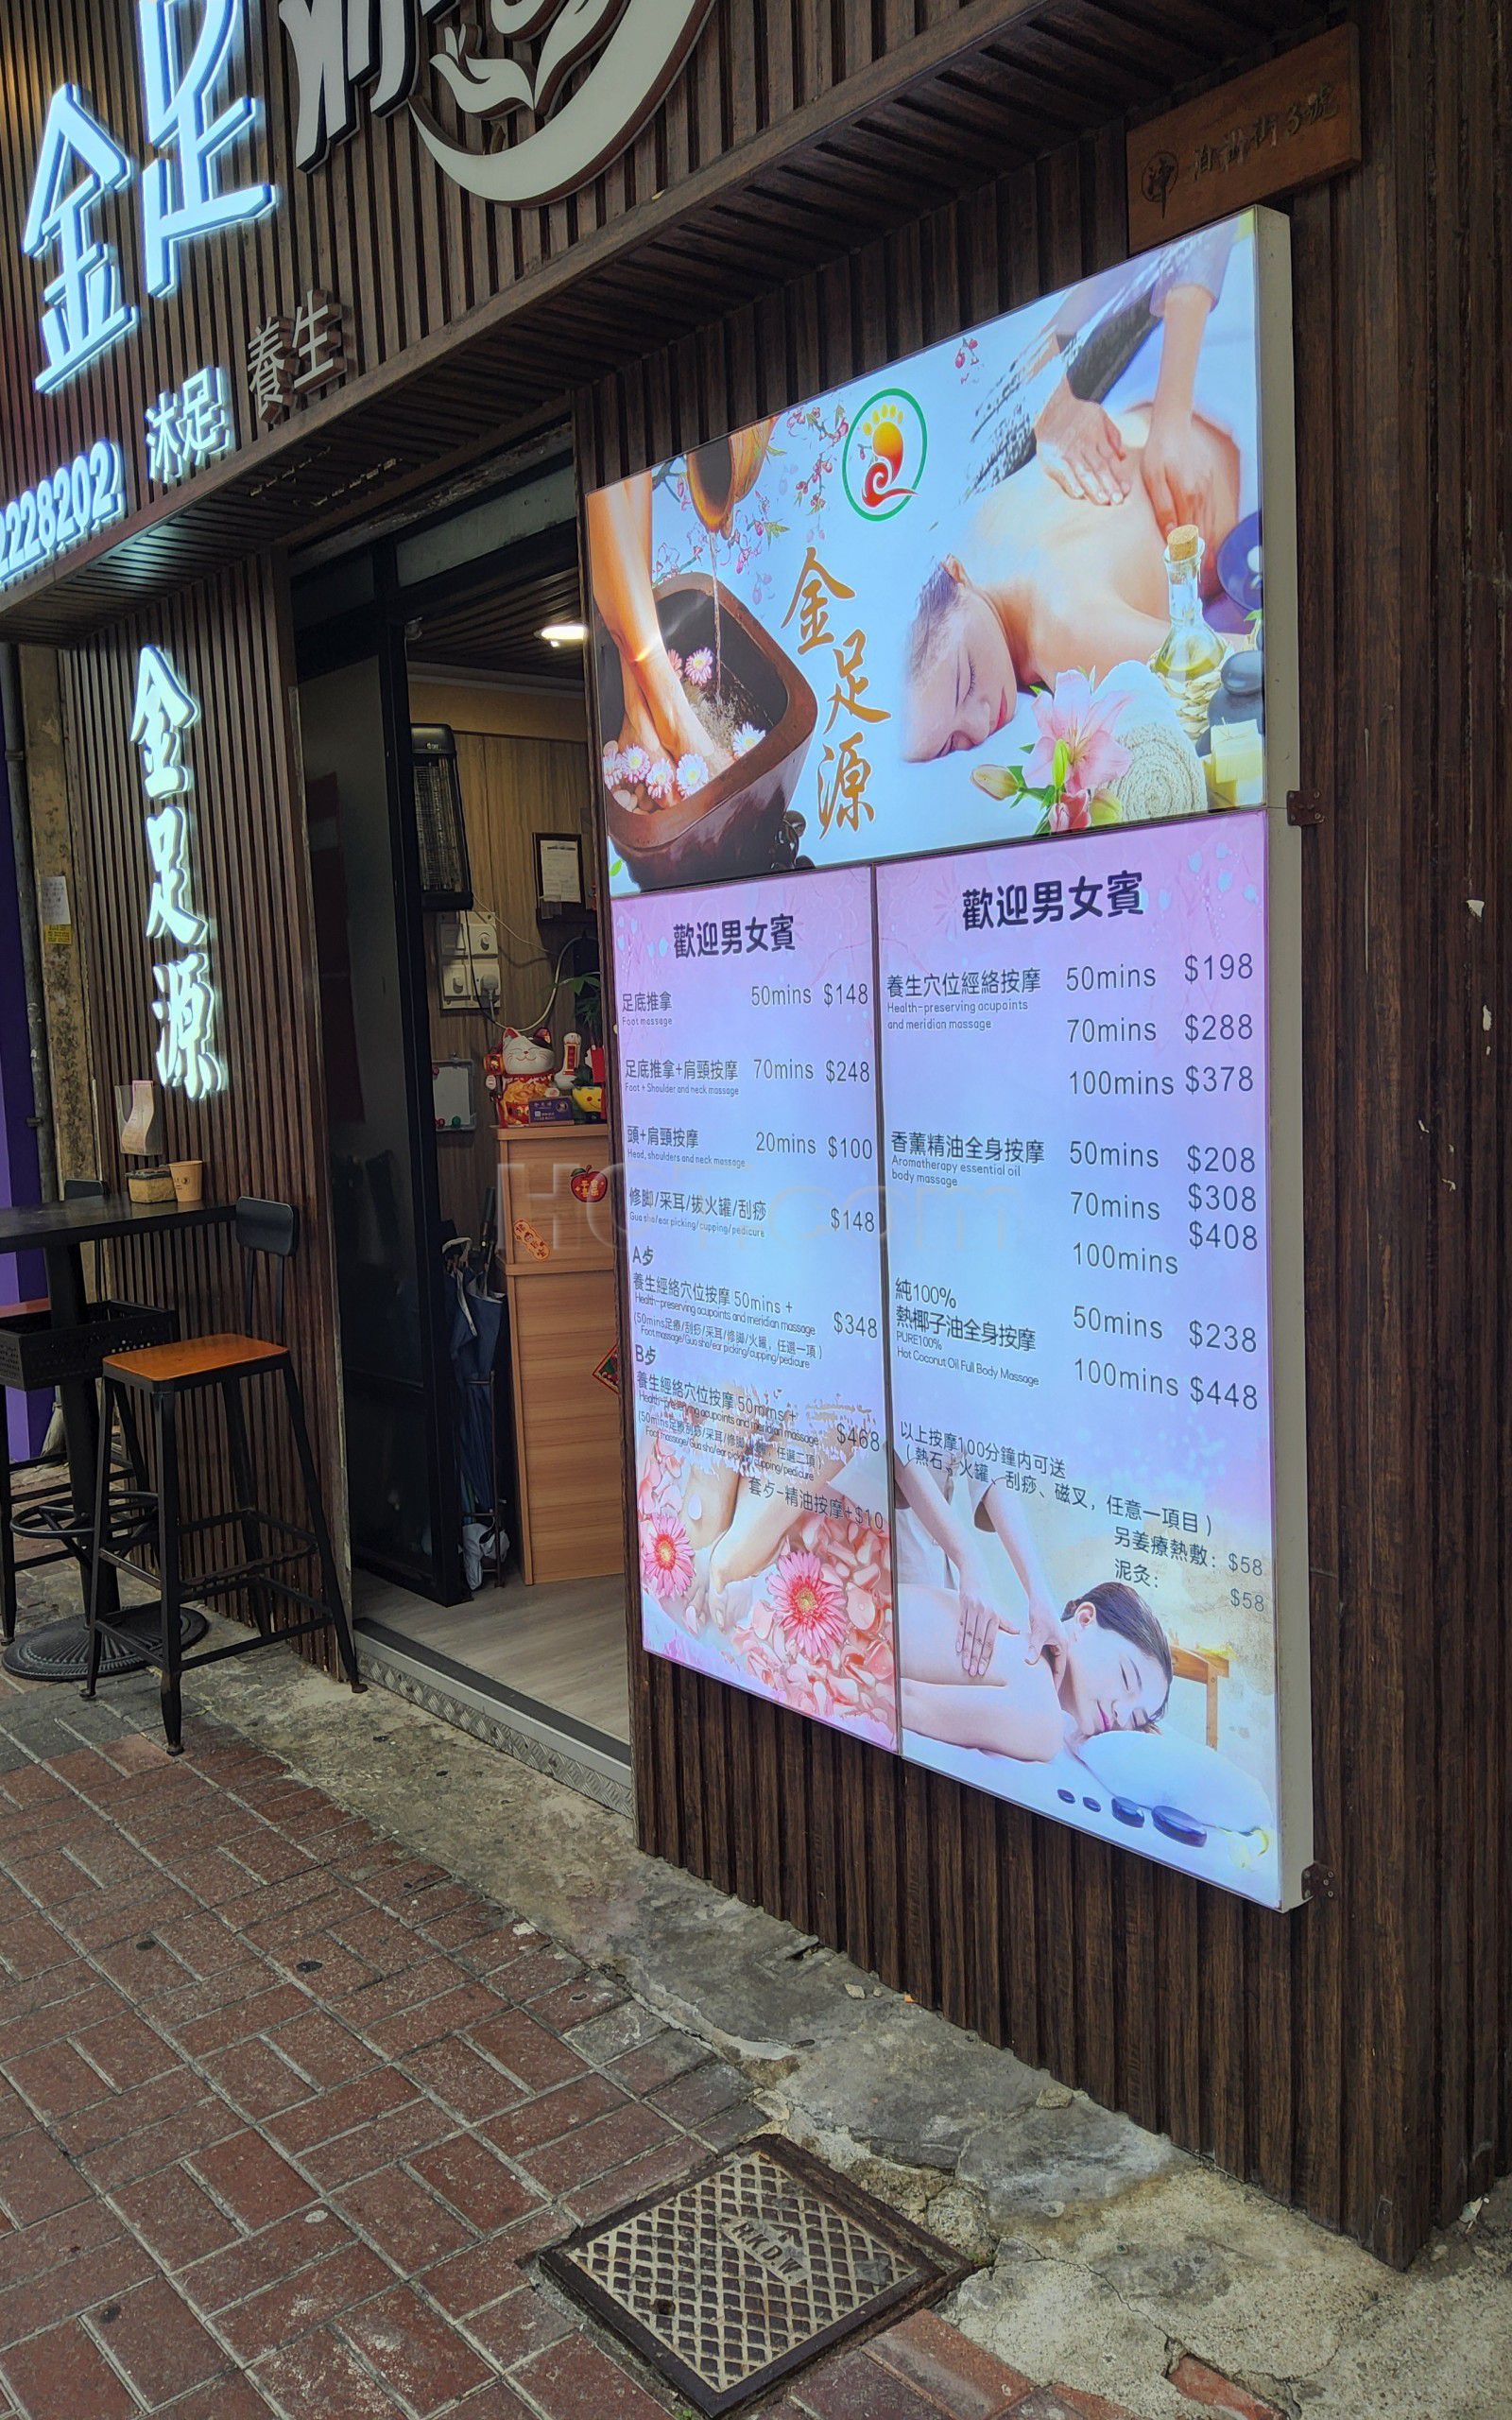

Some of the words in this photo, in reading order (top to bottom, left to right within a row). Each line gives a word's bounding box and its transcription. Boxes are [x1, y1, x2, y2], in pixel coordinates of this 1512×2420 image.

[248, 290, 335, 419] 養生
[781, 546, 891, 839] 金足源
[130, 644, 225, 1100] 金足源
[961, 870, 1143, 931] 歡迎男女賓
[673, 913, 796, 959] 歡迎男女賓
[886, 967, 1041, 998] 養生穴位經絡按摩
[1066, 963, 1156, 991] 50mins
[1184, 952, 1254, 984] $198
[622, 992, 672, 1012] 足底推拿
[751, 985, 812, 1007] 50mins
[823, 983, 868, 1008] $148
[887, 999, 976, 1015] Health-preserving
[977, 998, 1028, 1015] acupoints
[622, 1016, 639, 1026] Foot
[639, 1016, 673, 1027] massage
[887, 1018, 904, 1030] and
[905, 1017, 947, 1030] meridian
[948, 1018, 991, 1031] massage
[1067, 1016, 1157, 1043] 70mins
[1184, 1013, 1254, 1045] $288
[753, 1059, 814, 1080] 70mins
[825, 1060, 869, 1083] $248
[1069, 1069, 1175, 1096] 100mins
[1184, 1064, 1254, 1094] $378
[677, 1084, 689, 1095] and
[691, 1084, 708, 1095] neck
[709, 1087, 739, 1098] massage
[756, 1132, 816, 1155] 20mins
[828, 1135, 872, 1160] $100
[1069, 1140, 1160, 1168] 50mins
[1187, 1144, 1256, 1174] $208
[681, 1154, 695, 1165] and
[696, 1155, 713, 1166] neck
[713, 1158, 746, 1169] massage
[891, 1155, 958, 1175] Aromatherapy
[959, 1162, 1006, 1177] essential
[1007, 1164, 1022, 1178] oil
[891, 1168, 915, 1184] body
[917, 1172, 958, 1188] massage
[1070, 1190, 1160, 1221] 70mins
[1188, 1182, 1257, 1213] $308
[629, 1211, 643, 1222] Gua
[830, 1206, 875, 1233] $148
[1073, 1241, 1179, 1275] 100mins
[1189, 1219, 1258, 1252] $408
[633, 1272, 730, 1305] 養生經絡穴位按摩
[734, 1290, 781, 1314] 50mins
[895, 1277, 957, 1309] 純100%
[732, 1311, 747, 1323] and
[781, 1322, 816, 1337] massage
[833, 1311, 878, 1339] $348
[896, 1305, 1037, 1352] 熱椰子油全身按摩
[1073, 1305, 1163, 1340] 50mins
[1189, 1320, 1258, 1354] $238
[896, 1330, 943, 1351] PURE100%
[897, 1346, 912, 1359] Hot
[913, 1350, 947, 1368] Coconut
[948, 1357, 959, 1370] Oil
[960, 1359, 975, 1374] Full
[976, 1362, 999, 1380] Body
[1000, 1367, 1040, 1388] Massage
[1074, 1357, 1179, 1397] 100mins
[1190, 1376, 1259, 1411] $448
[836, 1424, 880, 1453] $468
[1228, 1552, 1263, 1577] $58
[1229, 1587, 1264, 1613] $58
